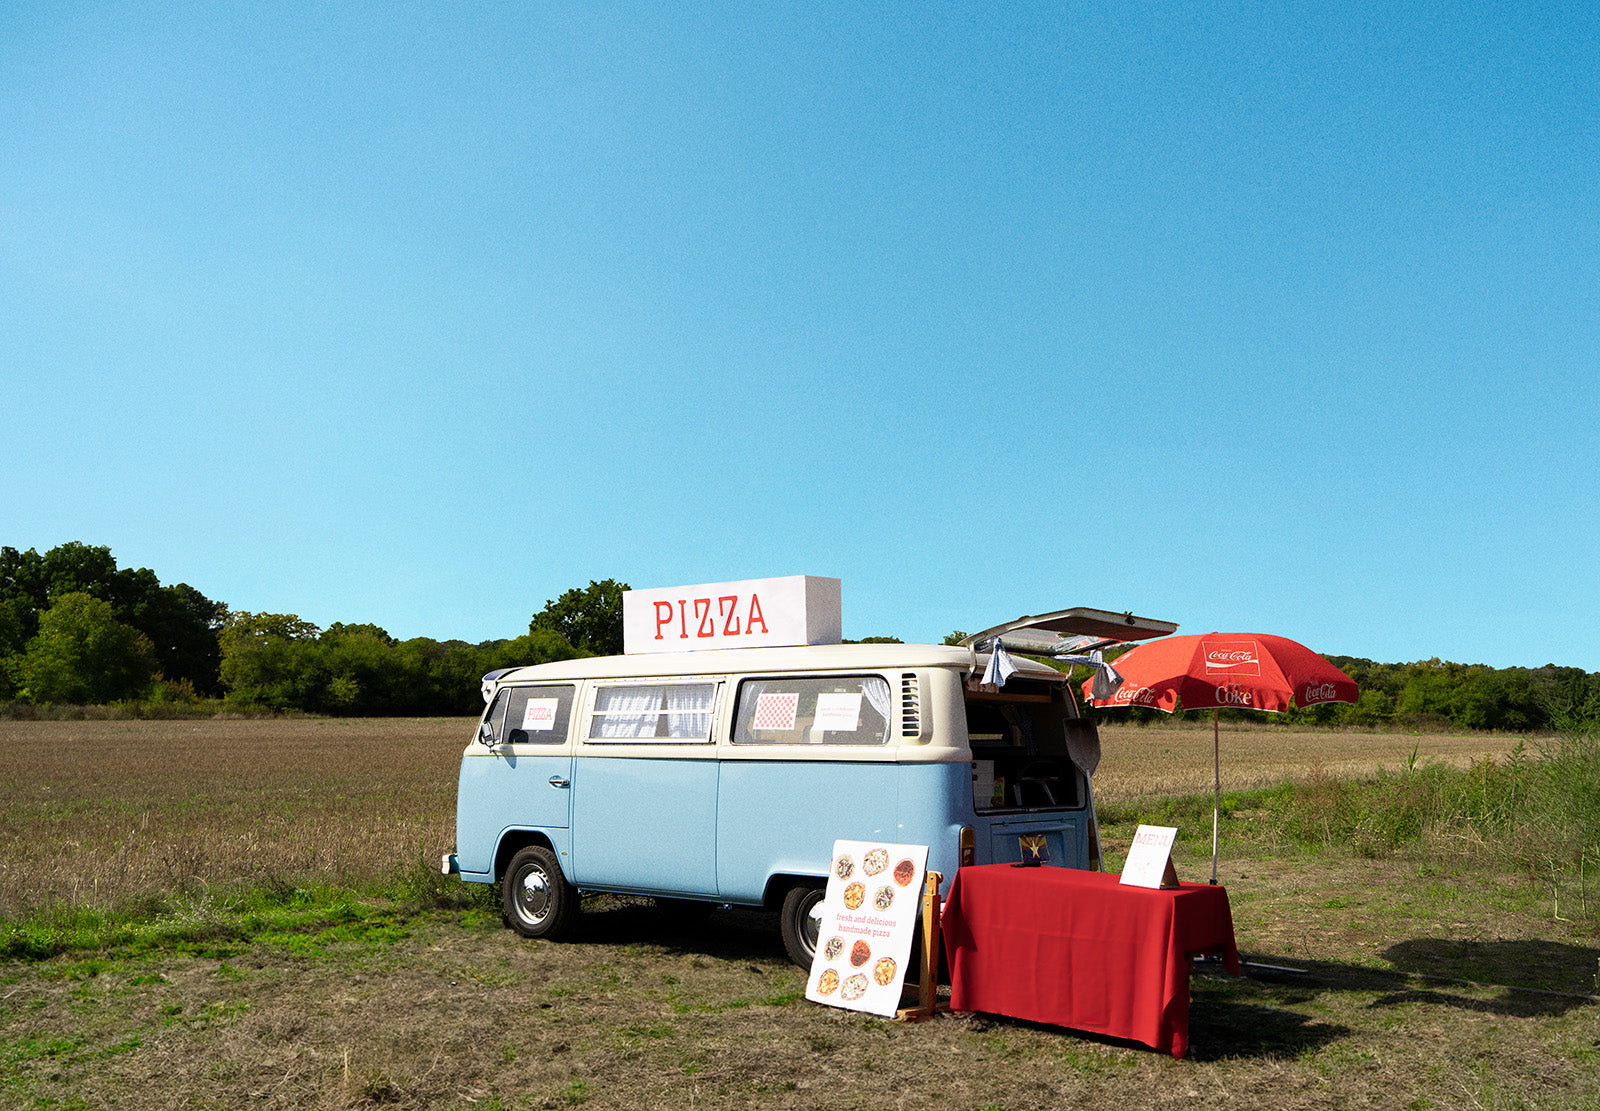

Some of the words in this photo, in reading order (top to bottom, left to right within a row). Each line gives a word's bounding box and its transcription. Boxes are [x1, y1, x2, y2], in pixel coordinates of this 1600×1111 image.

[653, 593, 769, 640] PIZZA
[1215, 685, 1252, 705] Coke
[527, 707, 553, 721] PIZZA
[1135, 832, 1174, 847] MENU
[836, 913, 853, 922] fresh
[854, 915, 867, 924] and
[867, 916, 897, 928] delicious
[838, 923, 872, 936] handmade
[872, 929, 891, 938] pizza
